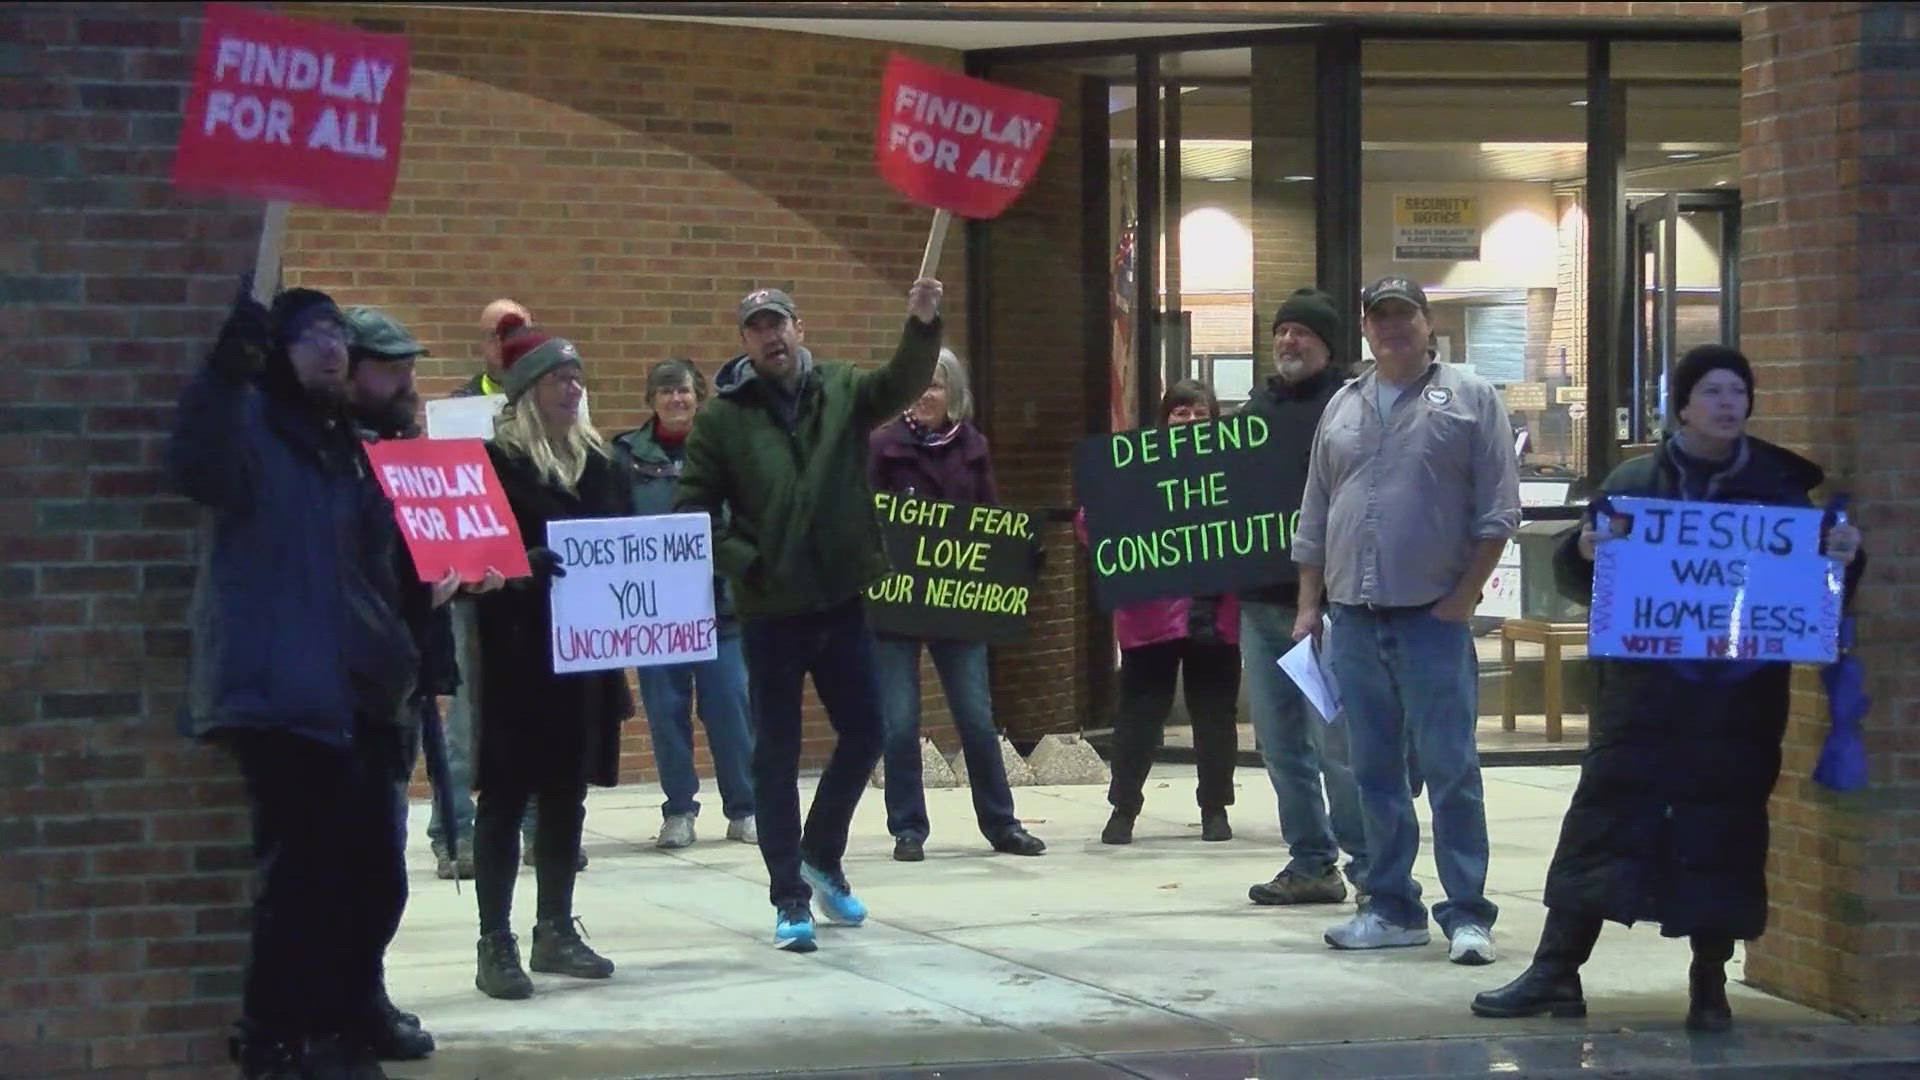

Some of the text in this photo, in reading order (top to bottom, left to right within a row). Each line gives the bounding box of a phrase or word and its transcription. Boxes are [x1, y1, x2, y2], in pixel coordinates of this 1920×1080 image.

[215, 38, 393, 104] FINDLAY
[204, 90, 387, 160] FOR ALL
[895, 84, 1042, 150] FINDLAY
[888, 122, 1023, 187] FOR ALL
[1112, 415, 1269, 468] DEFEND
[382, 464, 487, 498] FINDLAY
[1157, 471, 1229, 512] THE
[400, 503, 510, 540] FOR ALL
[874, 493, 1034, 540] FIGHT FEAR,
[1644, 509, 1796, 555] JESUS
[564, 533, 707, 567] DOES THIS MAKE
[916, 535, 992, 572] LOVE
[1671, 559, 1747, 588] WAS
[609, 580, 659, 620] YOU
[924, 577, 1029, 616] NEIGHBOR
[557, 617, 718, 662] UNCOMFORTABLE?
[1634, 597, 1819, 640] HOMEESS.
[1622, 634, 1683, 655] VOTE
